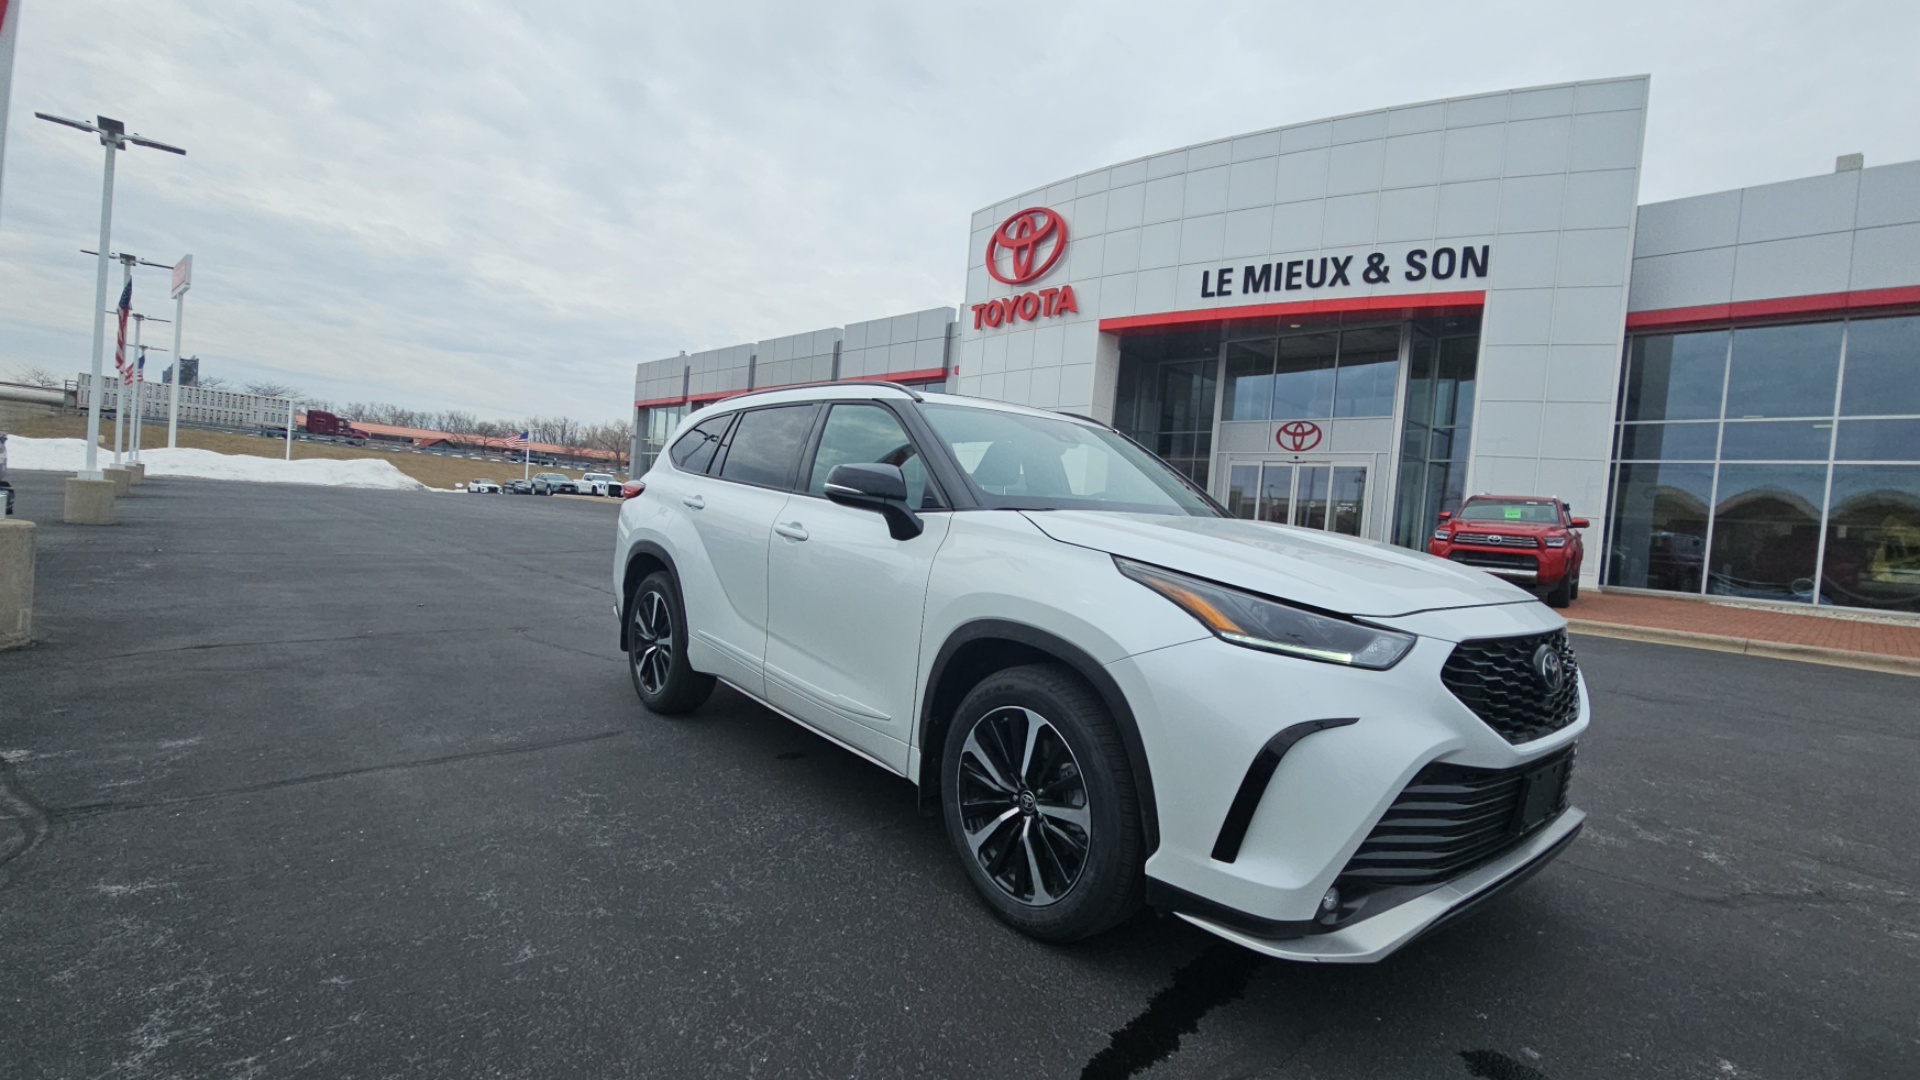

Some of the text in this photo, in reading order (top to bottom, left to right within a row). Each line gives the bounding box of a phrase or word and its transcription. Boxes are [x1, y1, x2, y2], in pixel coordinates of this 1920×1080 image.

[1200, 244, 1490, 298] LE MIEUX & SON
[971, 285, 1078, 330] TOYOTA
